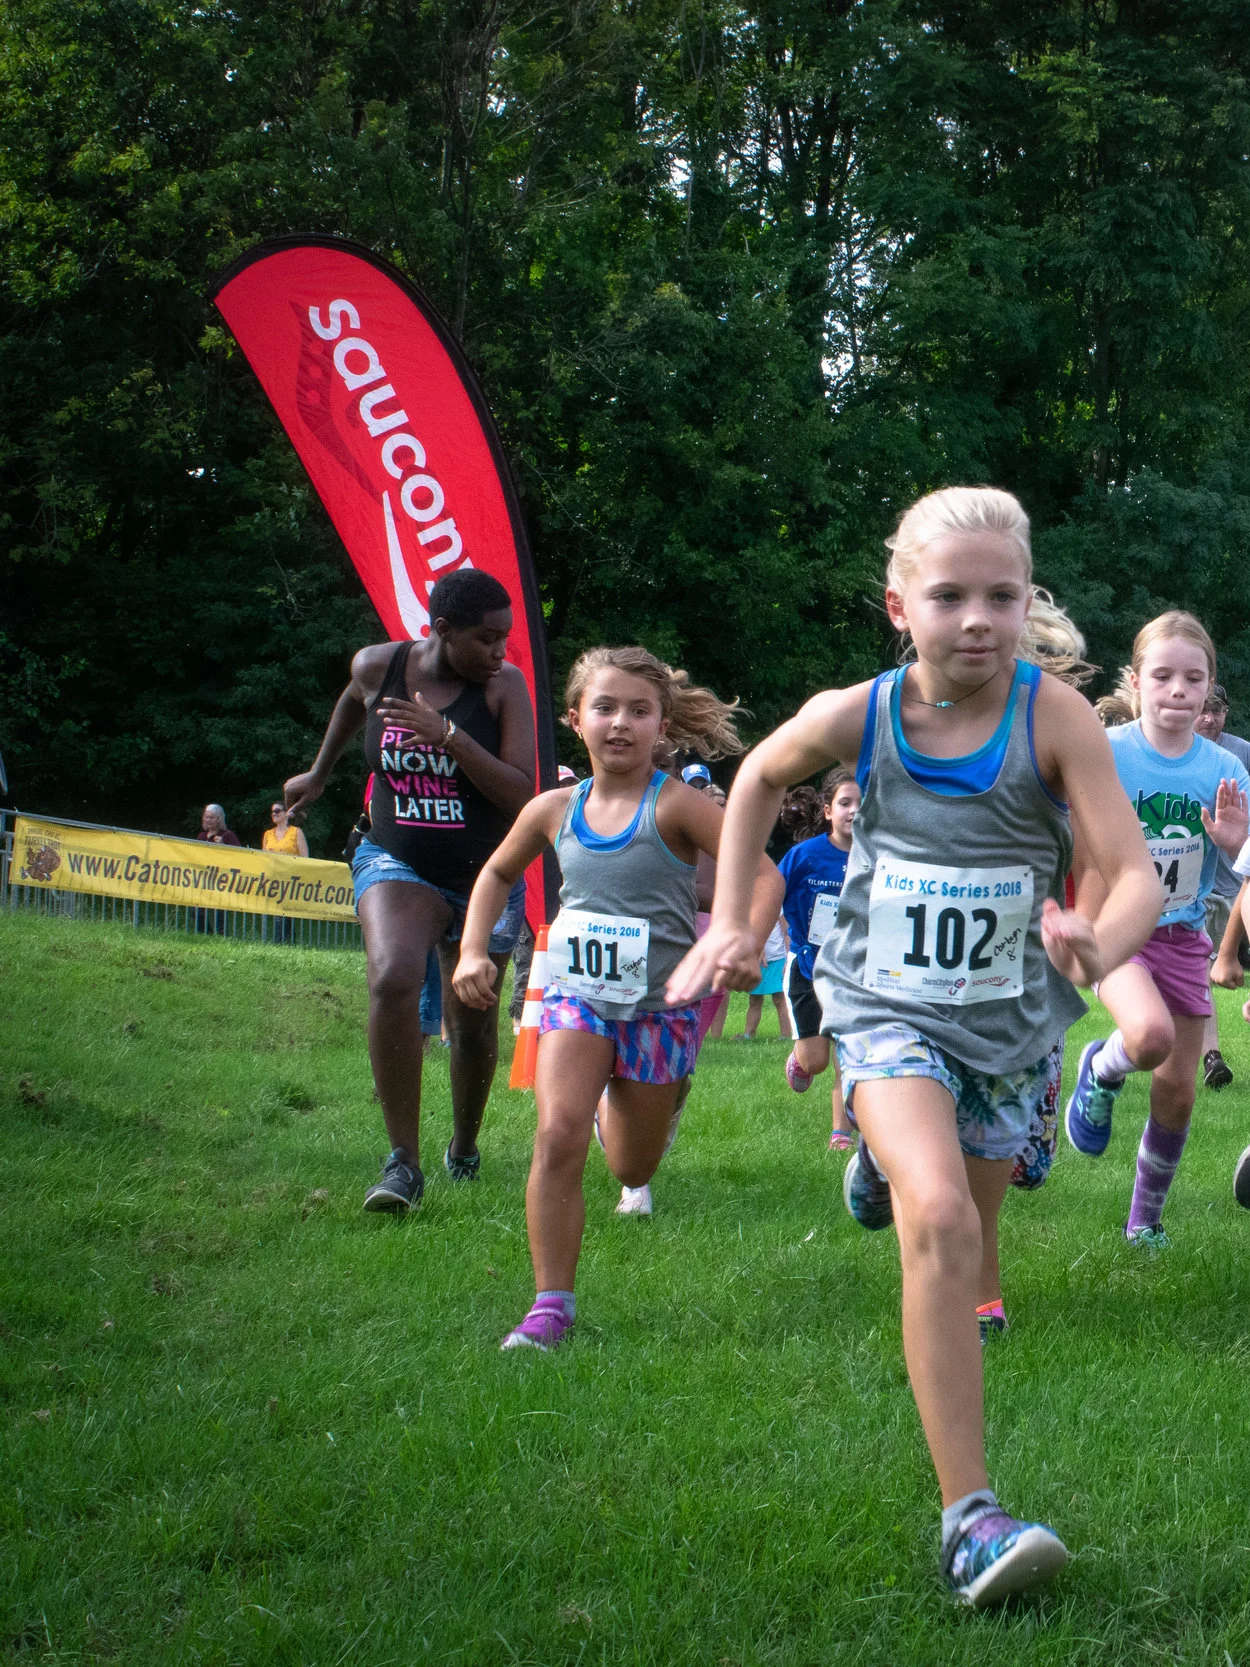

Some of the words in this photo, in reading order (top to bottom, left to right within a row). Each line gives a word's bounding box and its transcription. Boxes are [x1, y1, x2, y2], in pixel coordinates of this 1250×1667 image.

[308, 298, 475, 596] saucon
[381, 749, 458, 777] NOW
[385, 772, 458, 797] WINE
[394, 795, 465, 821] LATER
[1136, 788, 1201, 823] Kids
[1158, 846, 1185, 856] Series
[885, 874, 914, 892] Kids
[918, 879, 936, 895] XC
[941, 882, 990, 899] Series
[994, 881, 1023, 898] 2018
[820, 899, 833, 908] Kids
[587, 922, 617, 935] Series
[619, 926, 641, 937] 2018
[903, 903, 998, 971] 102
[567, 936, 622, 982] 101
